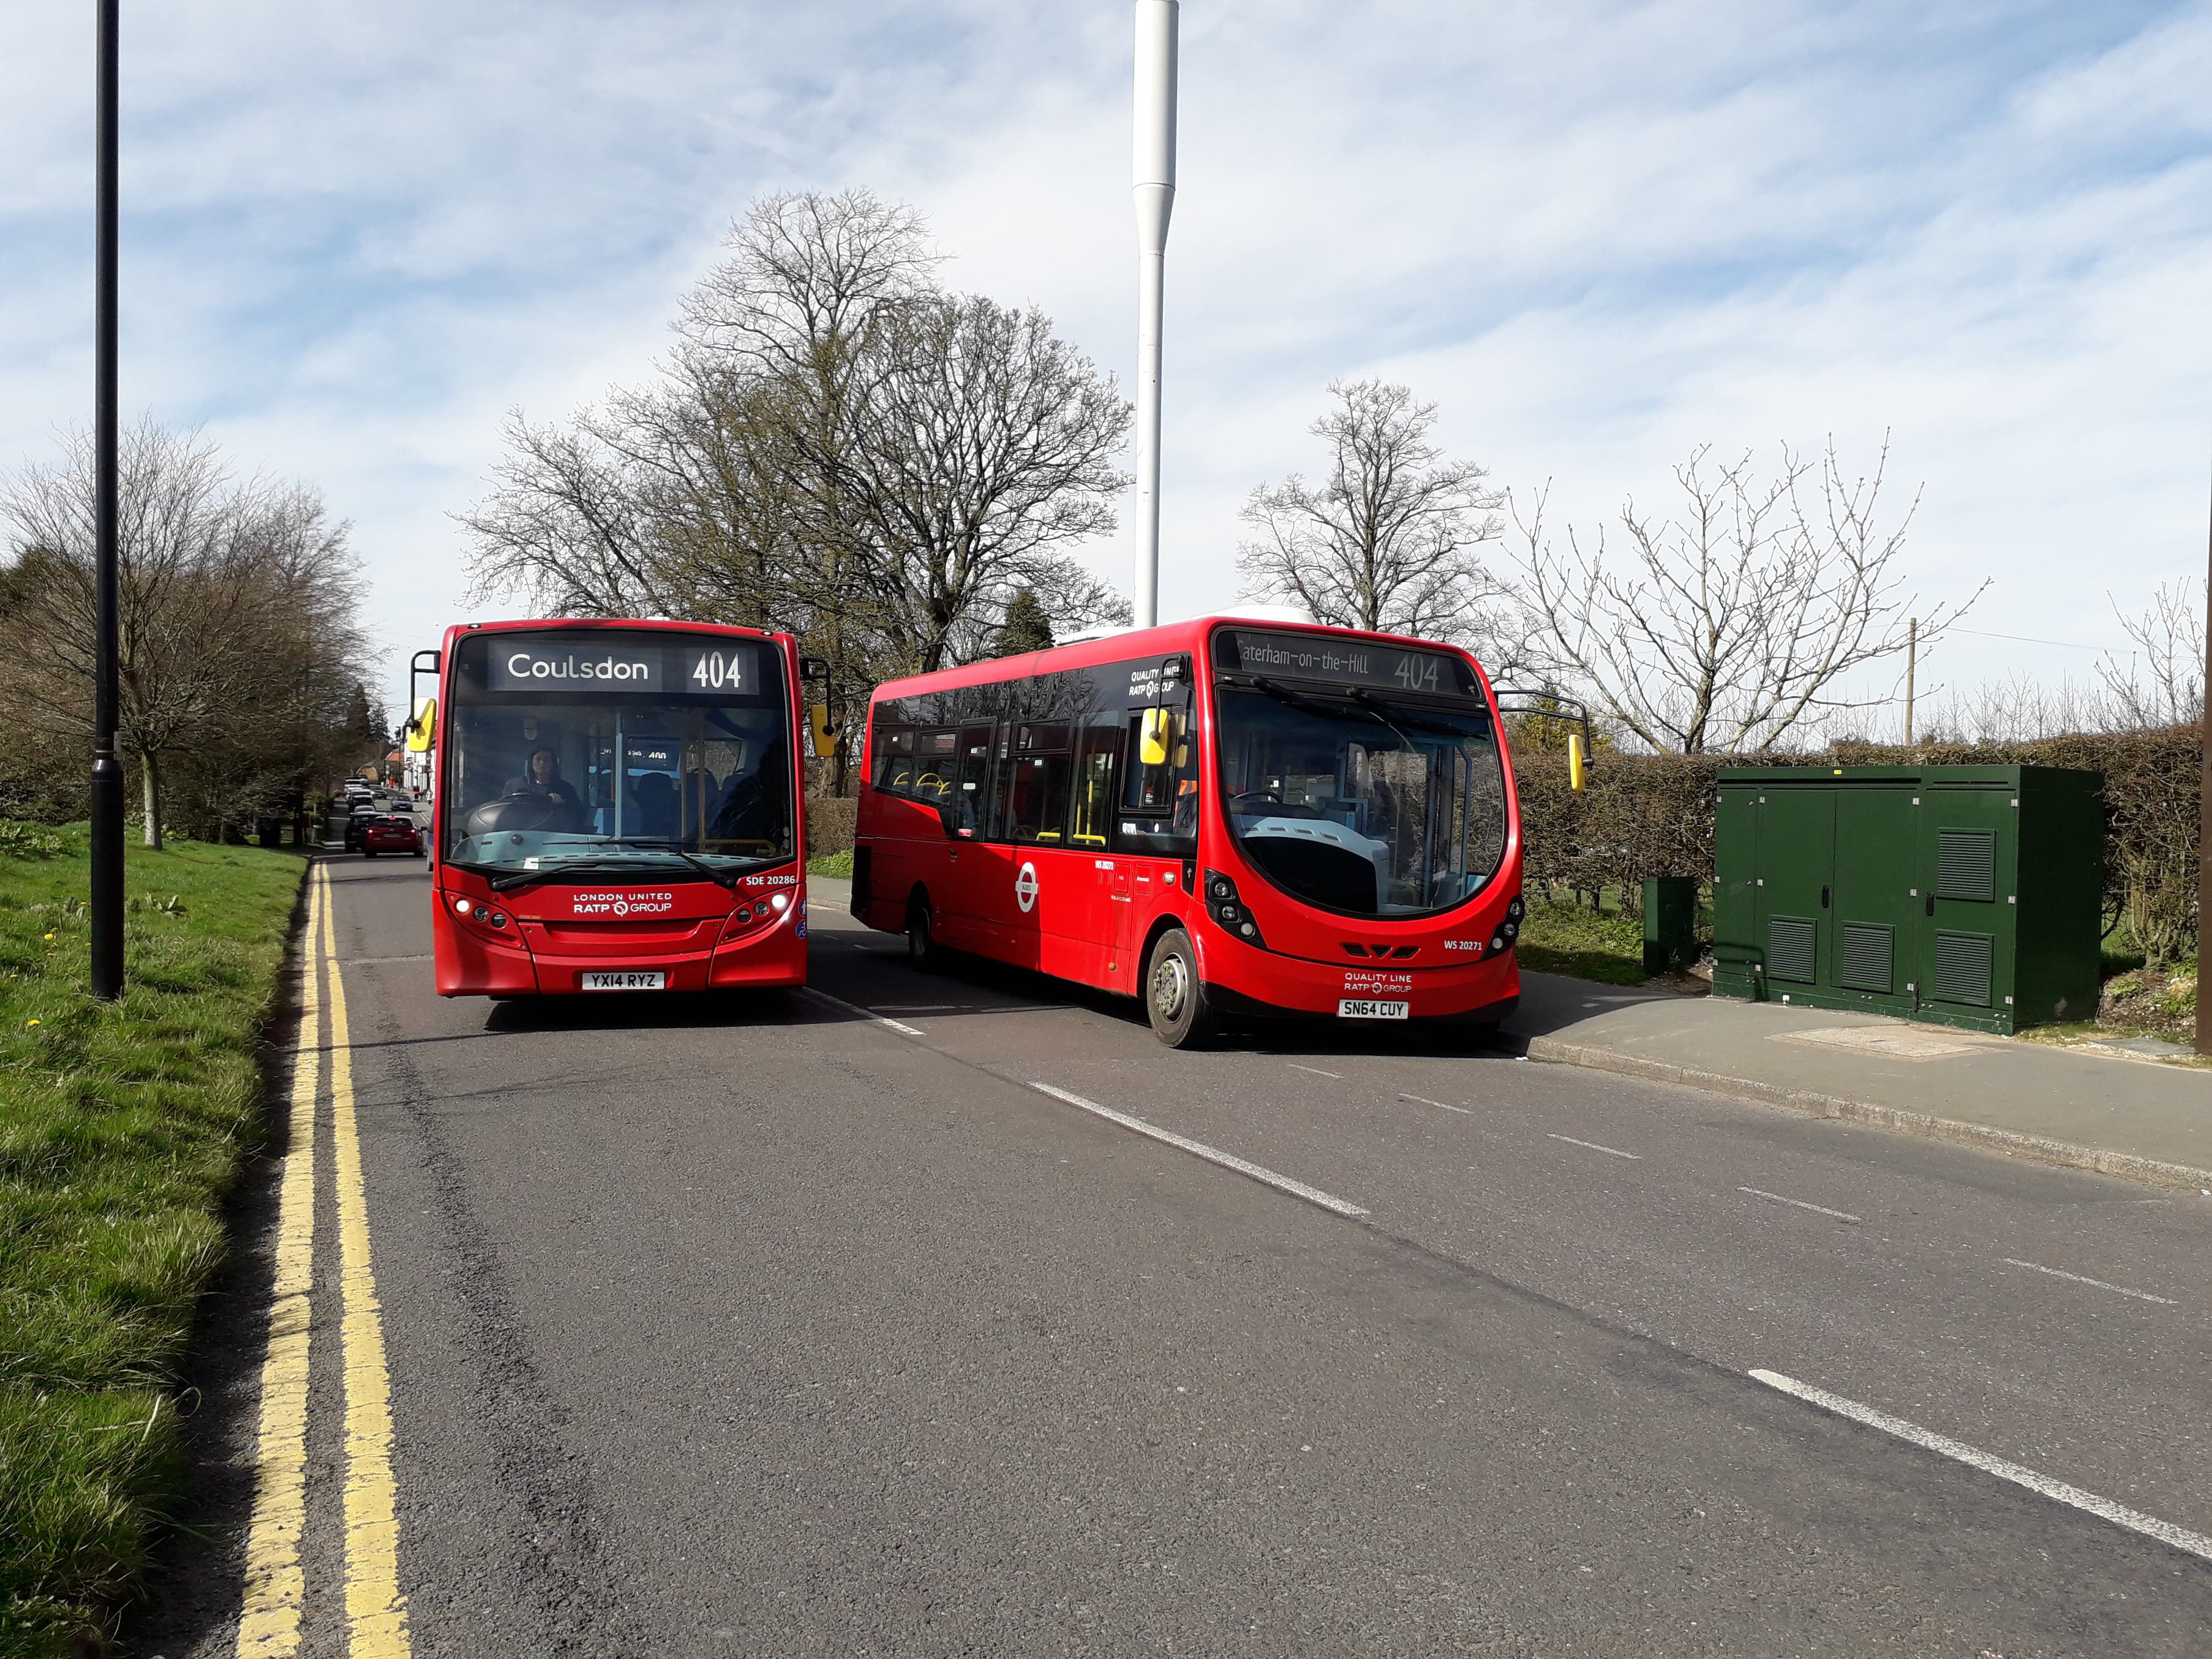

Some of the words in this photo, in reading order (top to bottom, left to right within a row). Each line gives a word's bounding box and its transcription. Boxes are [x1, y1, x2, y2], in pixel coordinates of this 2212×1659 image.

[508, 653, 648, 679] Coulsdon
[693, 651, 741, 688] 404
[1131, 669, 1159, 682] QUALITY
[1162, 666, 1178, 675] IN
[1394, 654, 1439, 691] 404
[1129, 685, 1145, 696] RATP
[1154, 681, 1174, 693] GOUP
[746, 876, 765, 885] SDE
[767, 876, 796, 884] 20286
[574, 904, 610, 913] RATP
[630, 903, 672, 912] GROUP
[1444, 941, 1457, 949] WS
[1459, 941, 1482, 950] 20271
[592, 974, 623, 987] YX14
[628, 974, 656, 987] RYZ
[1345, 972, 1387, 982] QUALITY
[1344, 1002, 1376, 1015] SN64
[1380, 1003, 1404, 1016] CUY
